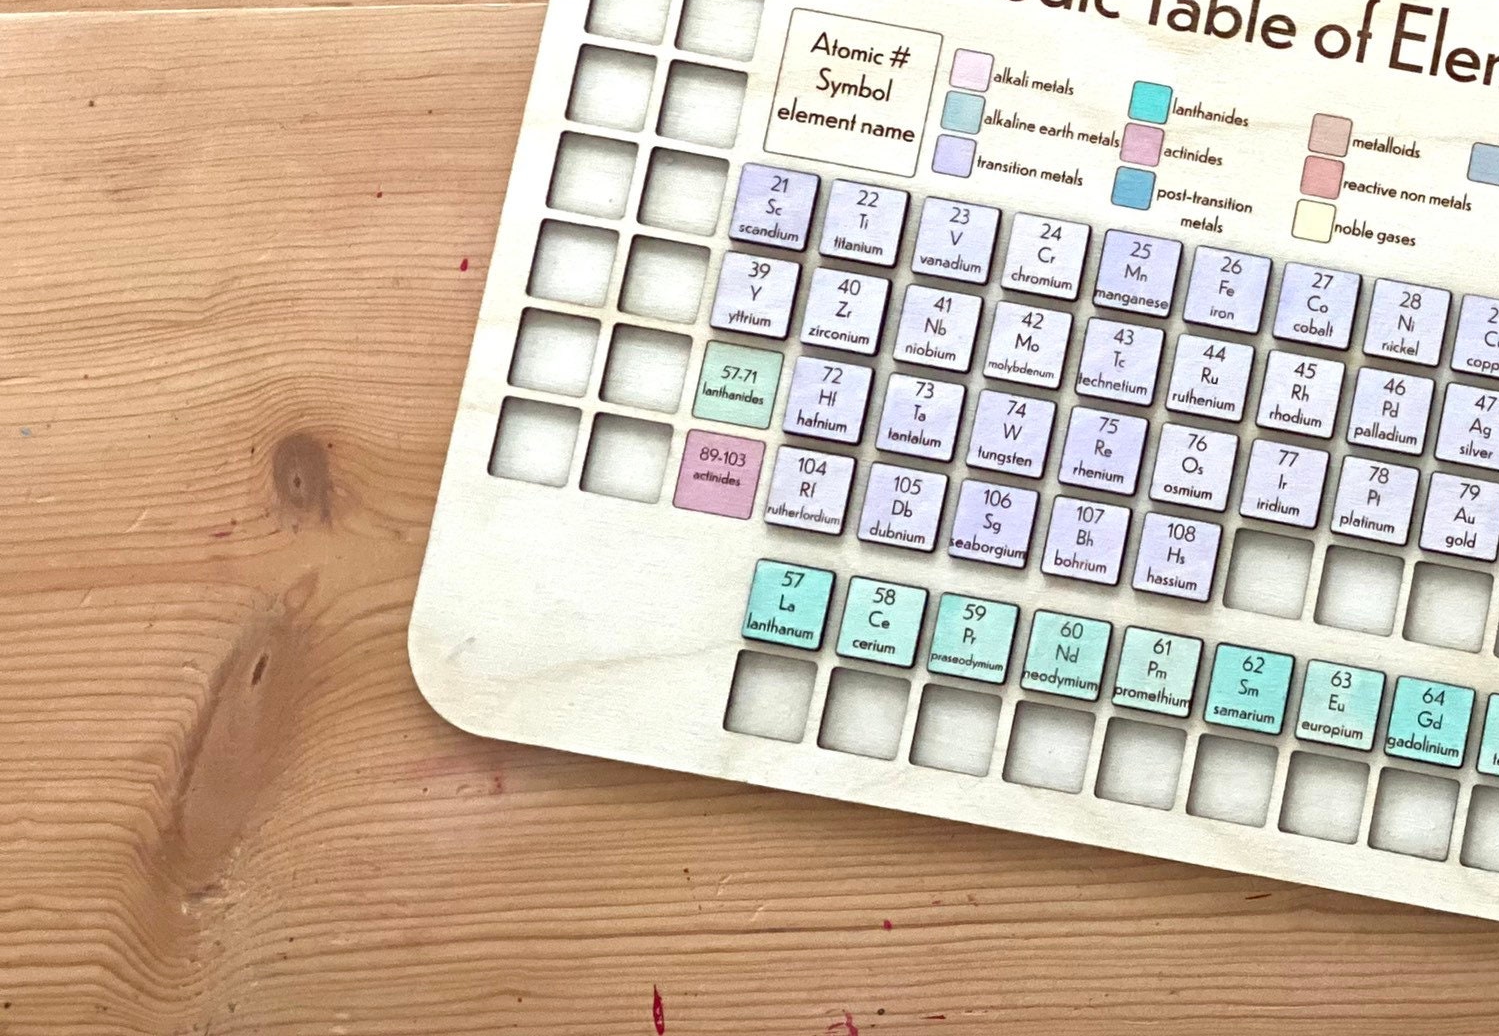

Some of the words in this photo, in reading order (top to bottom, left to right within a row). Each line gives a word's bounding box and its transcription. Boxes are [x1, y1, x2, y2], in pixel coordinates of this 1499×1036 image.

[810, 32, 884, 66] Atomic
[889, 45, 911, 69] #
[815, 68, 892, 102] Symbol
[993, 71, 1029, 90] alkali
[1031, 75, 1075, 96] metals
[777, 98, 857, 131] element
[862, 119, 916, 144] name
[1172, 97, 1250, 127] lanthanides
[983, 113, 1037, 135] alkaline
[1039, 121, 1075, 141] earth
[1077, 126, 1120, 149] metals
[1163, 145, 1223, 167] actinides
[1352, 136, 1421, 160] metalloids
[976, 155, 1037, 179] transition
[1040, 164, 1083, 186] metals
[770, 174, 790, 194] 21
[1343, 177, 1397, 200] reactive
[1400, 189, 1426, 204] non
[1429, 190, 1472, 211] metals
[764, 197, 783, 217] Sc
[1156, 186, 1253, 215] post-transition
[738, 221, 800, 243] scandium
[1038, 222, 1063, 242] 24
[1180, 213, 1223, 234] metals
[1334, 220, 1373, 240] noble
[1376, 229, 1416, 247] gases
[1037, 246, 1057, 264] Cr
[1220, 255, 1243, 276] 26
[836, 278, 862, 297] 40
[1010, 267, 1073, 291] chromium
[1218, 279, 1236, 298] Fe
[834, 300, 853, 319] Zr
[932, 295, 953, 314] 41
[1209, 305, 1235, 321] iron
[807, 324, 871, 346] zirconium
[923, 316, 947, 337] Nb
[904, 340, 957, 362] niobium
[720, 364, 758, 385] 57-71
[1292, 361, 1318, 380] 45
[701, 380, 765, 406] lanthanides
[1290, 383, 1310, 403] Rh
[1473, 394, 1499, 413] 47
[1268, 406, 1323, 429] rhodium
[1468, 417, 1493, 440] Ag
[1187, 432, 1208, 453] 76
[1458, 439, 1494, 460] silver
[699, 446, 747, 468] 89-103
[1181, 455, 1204, 476] Os
[893, 474, 924, 496] 105
[1163, 483, 1213, 501] osmium
[1459, 482, 1482, 502] 79
[890, 498, 914, 519] Db
[1452, 505, 1476, 526] Au
[868, 522, 926, 545] dubnium
[1167, 522, 1197, 543] 108
[1444, 530, 1478, 550] gold
[1166, 545, 1186, 565] Hs
[1146, 567, 1198, 592] hassium
[872, 586, 897, 607] 58
[867, 610, 891, 630] Ce
[851, 638, 896, 655] cerium
[1241, 654, 1266, 675] 62
[1237, 678, 1260, 698] Sm
[1330, 670, 1353, 690] 63
[1327, 693, 1346, 713] Eu
[1212, 705, 1276, 725] samarium
[1300, 720, 1364, 741] europium
